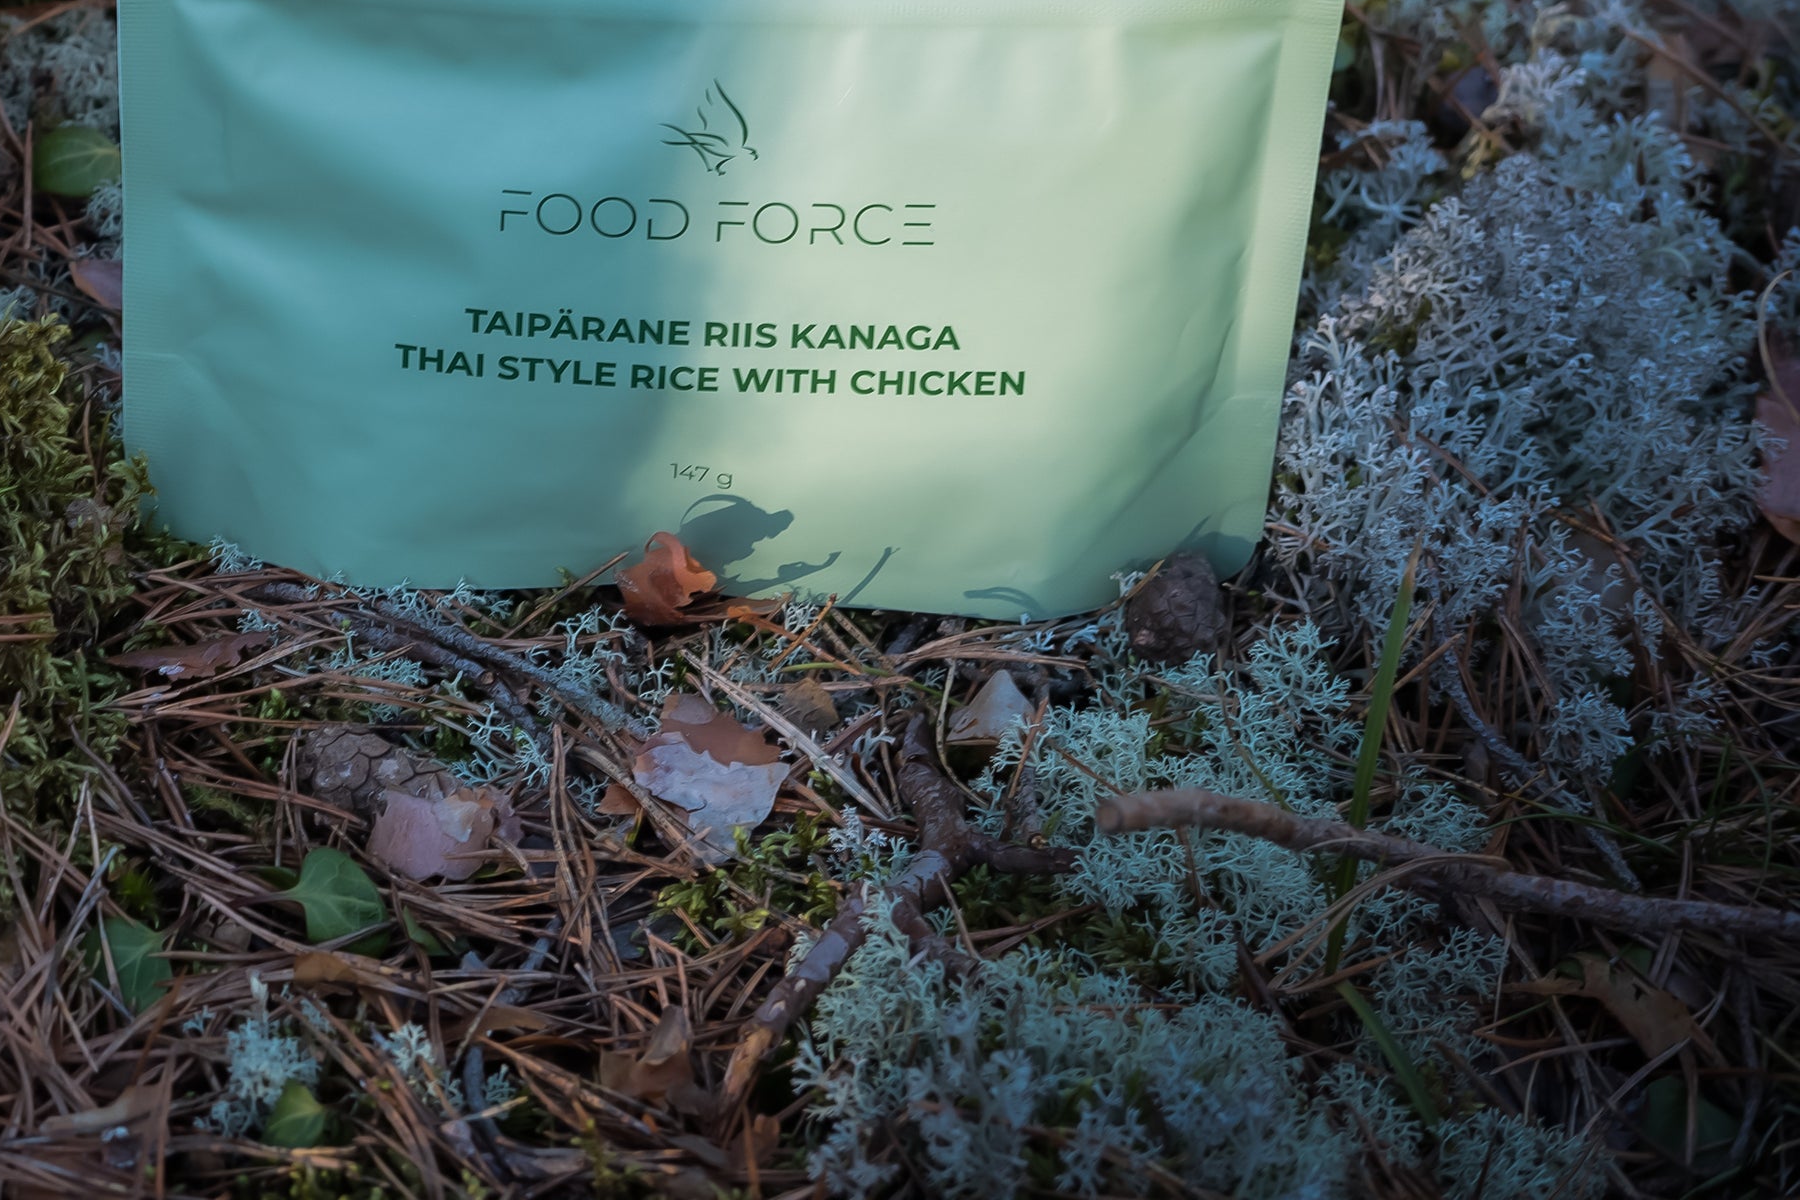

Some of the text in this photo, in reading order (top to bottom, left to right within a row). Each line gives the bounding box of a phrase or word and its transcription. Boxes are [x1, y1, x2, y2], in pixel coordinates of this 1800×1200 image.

[500, 189, 937, 246] FOOD FORCE
[465, 308, 961, 351] TAIPÄRANE RIIS KANAGA
[395, 343, 1027, 397] THAI STYLE RICE WITH CHICKEN
[669, 462, 734, 490] 147 g
